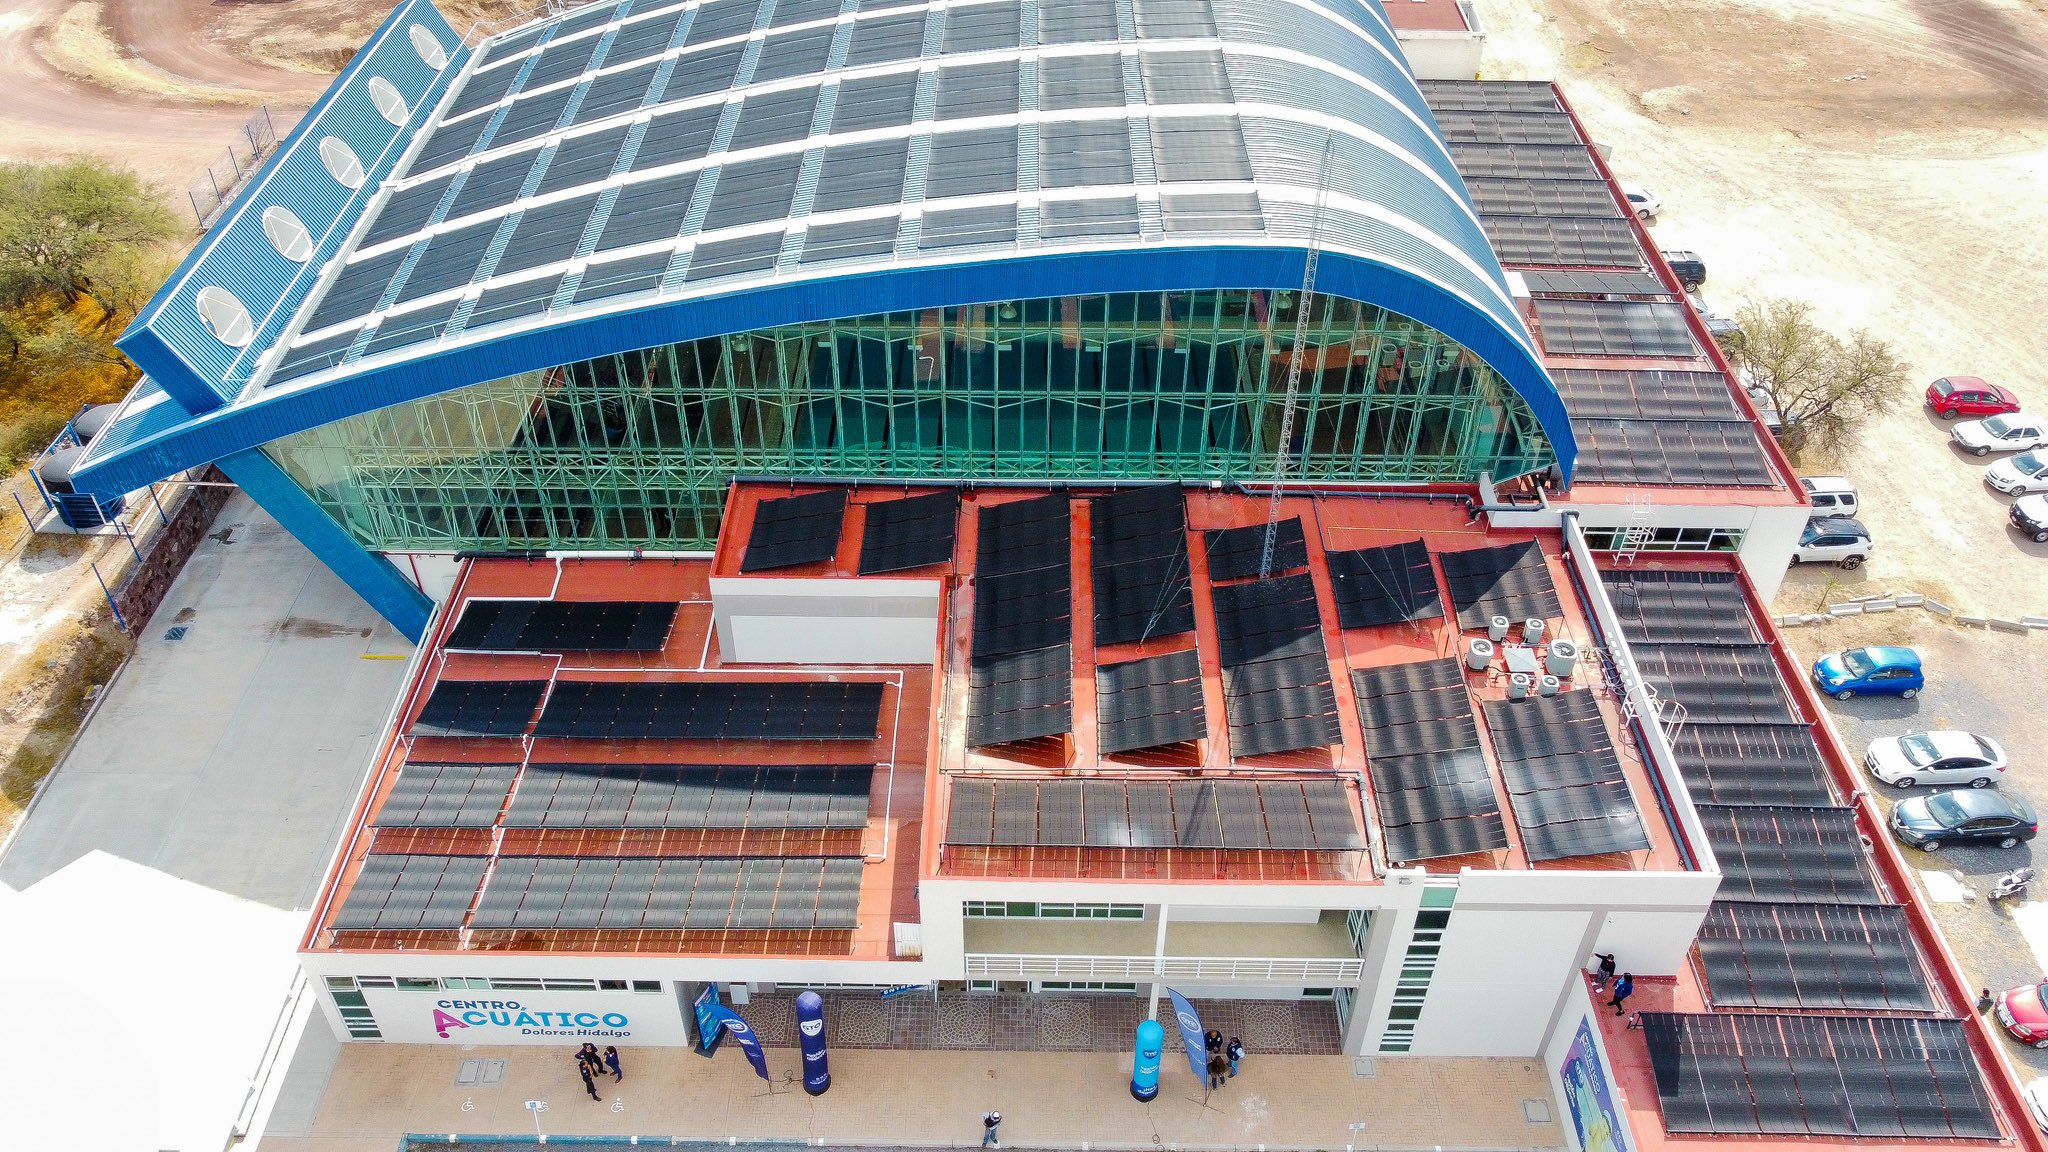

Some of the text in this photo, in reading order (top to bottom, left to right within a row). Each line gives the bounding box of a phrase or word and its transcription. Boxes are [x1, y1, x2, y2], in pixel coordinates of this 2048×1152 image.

[437, 1000, 520, 1010] CENTRO
[433, 1007, 629, 1039] ACUÁTICO
[522, 1028, 631, 1039] Dolores Hidalgo
